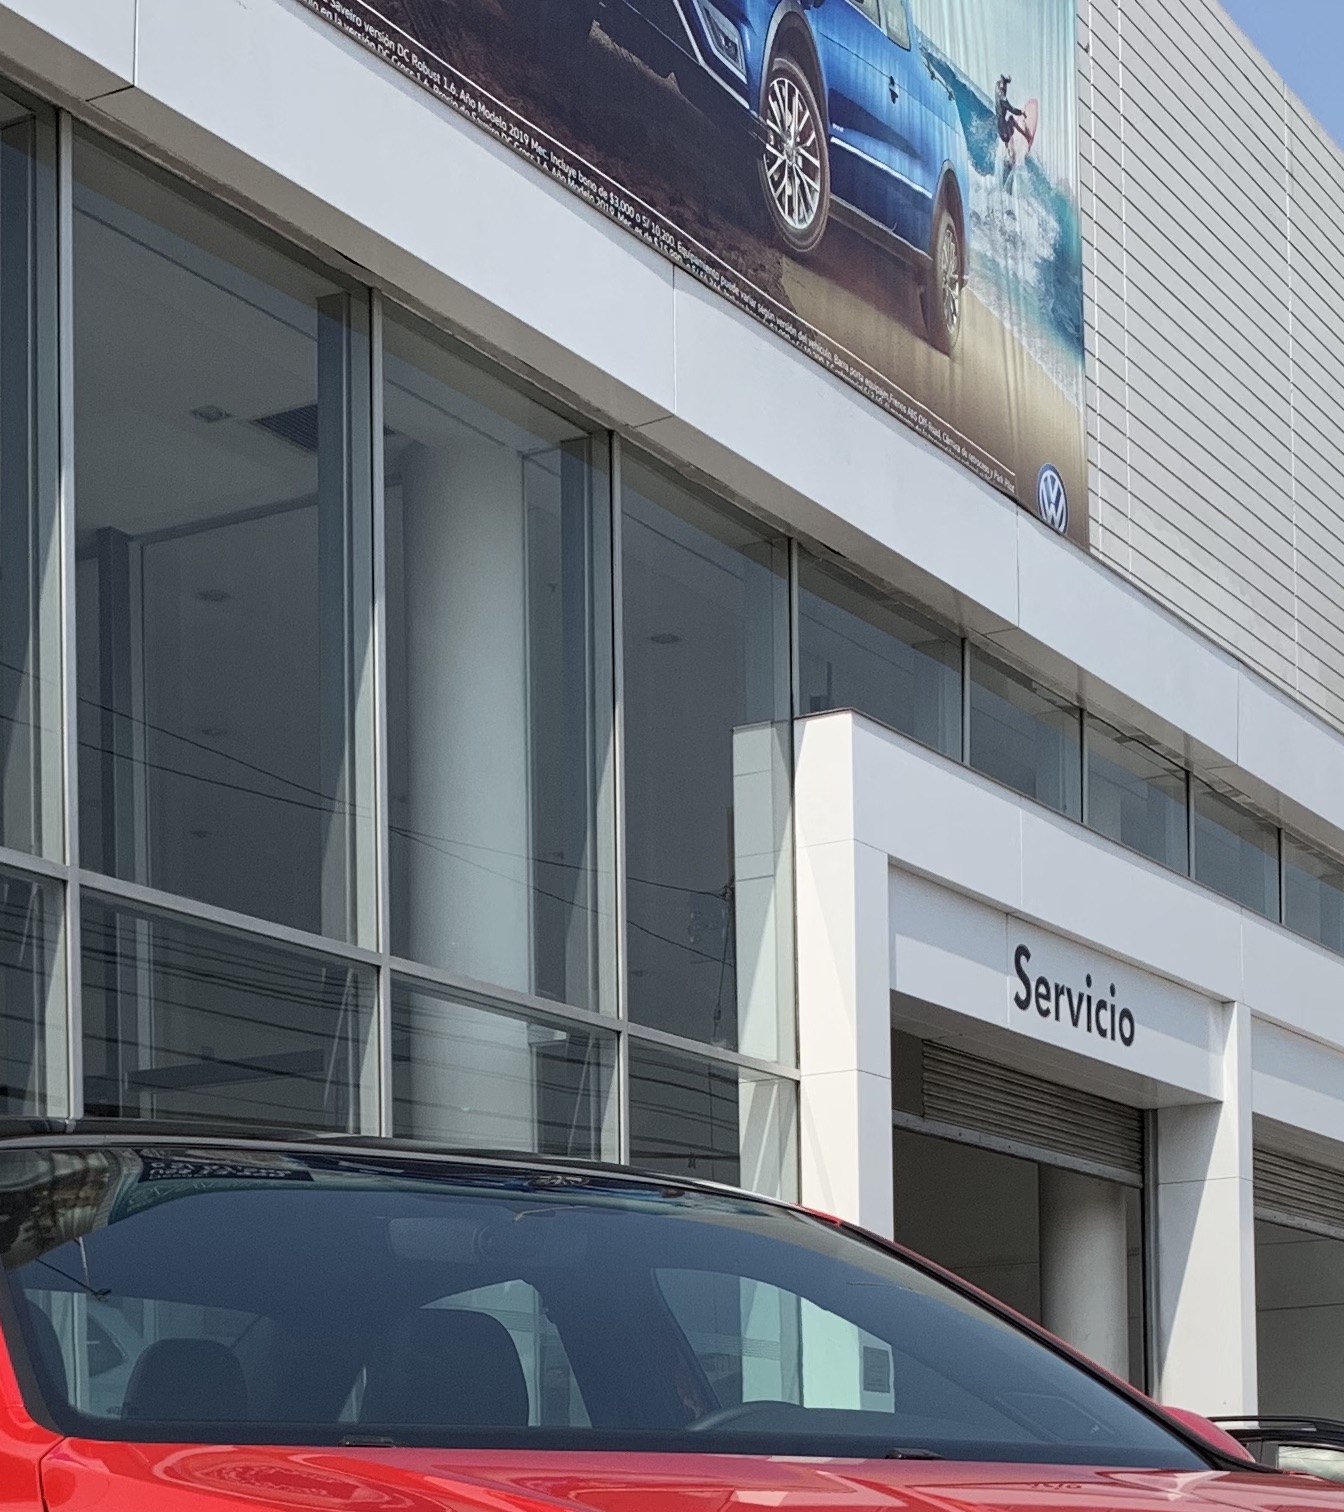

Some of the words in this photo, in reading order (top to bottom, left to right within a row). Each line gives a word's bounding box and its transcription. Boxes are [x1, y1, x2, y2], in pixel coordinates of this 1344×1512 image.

[363, 21, 394, 51] versión
[396, 42, 409, 62] DC
[411, 52, 440, 84] Robust
[459, 88, 476, 109] Año
[477, 101, 506, 130] Modelo
[508, 123, 529, 145] 2019
[550, 152, 576, 178] Incluye
[578, 171, 597, 191] bono
[598, 187, 608, 199] de
[608, 192, 634, 218] $3,000
[677, 241, 719, 280] Equipamiento
[1014, 943, 1135, 1046] Servicio
